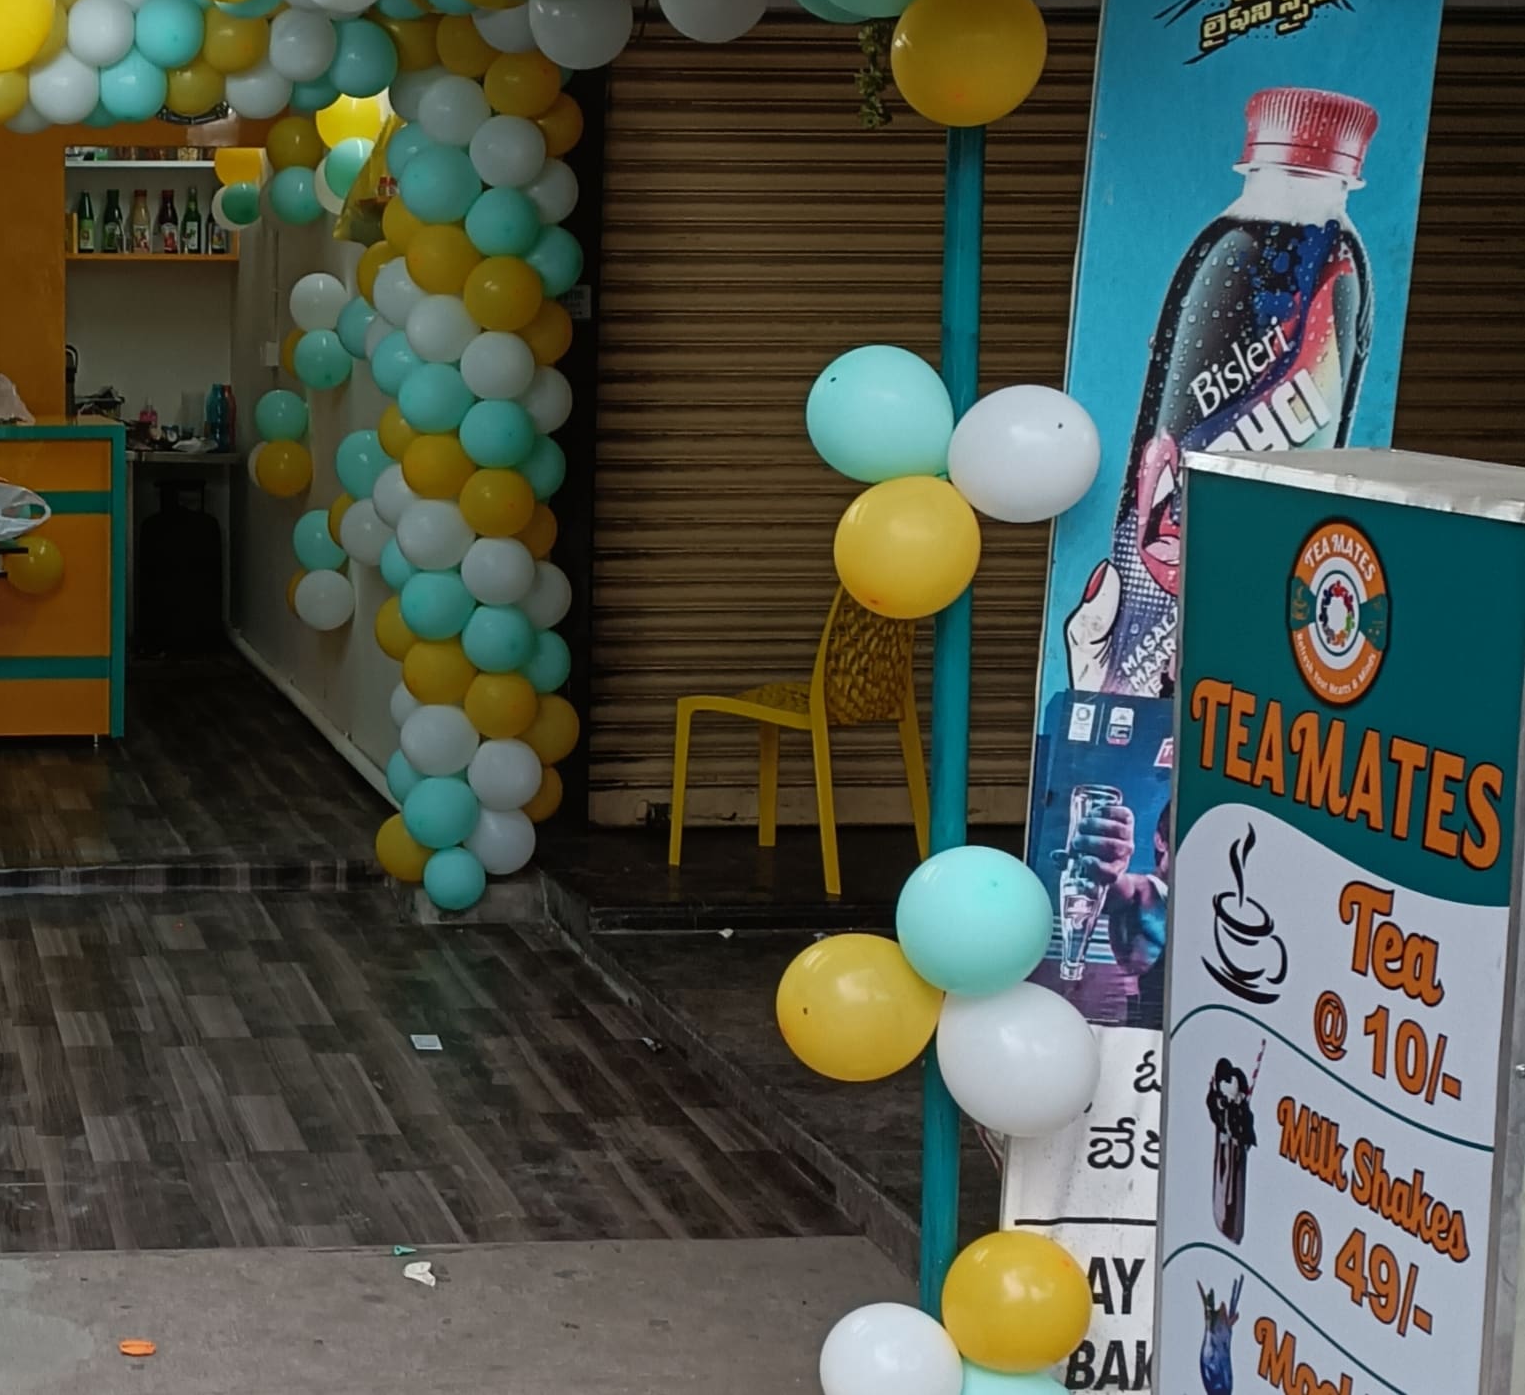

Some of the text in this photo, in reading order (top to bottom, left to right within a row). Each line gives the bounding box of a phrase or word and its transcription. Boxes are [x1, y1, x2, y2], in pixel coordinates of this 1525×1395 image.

[1190, 316, 1291, 418] Bisleri
[1304, 533, 1376, 582] TEA MATES
[1339, 880, 1445, 1007] Tea
[1313, 989, 1462, 1105] @ 10/-
[1277, 1095, 1470, 1264] Milk Shakes
[1291, 1210, 1433, 1338] @ 49/-
